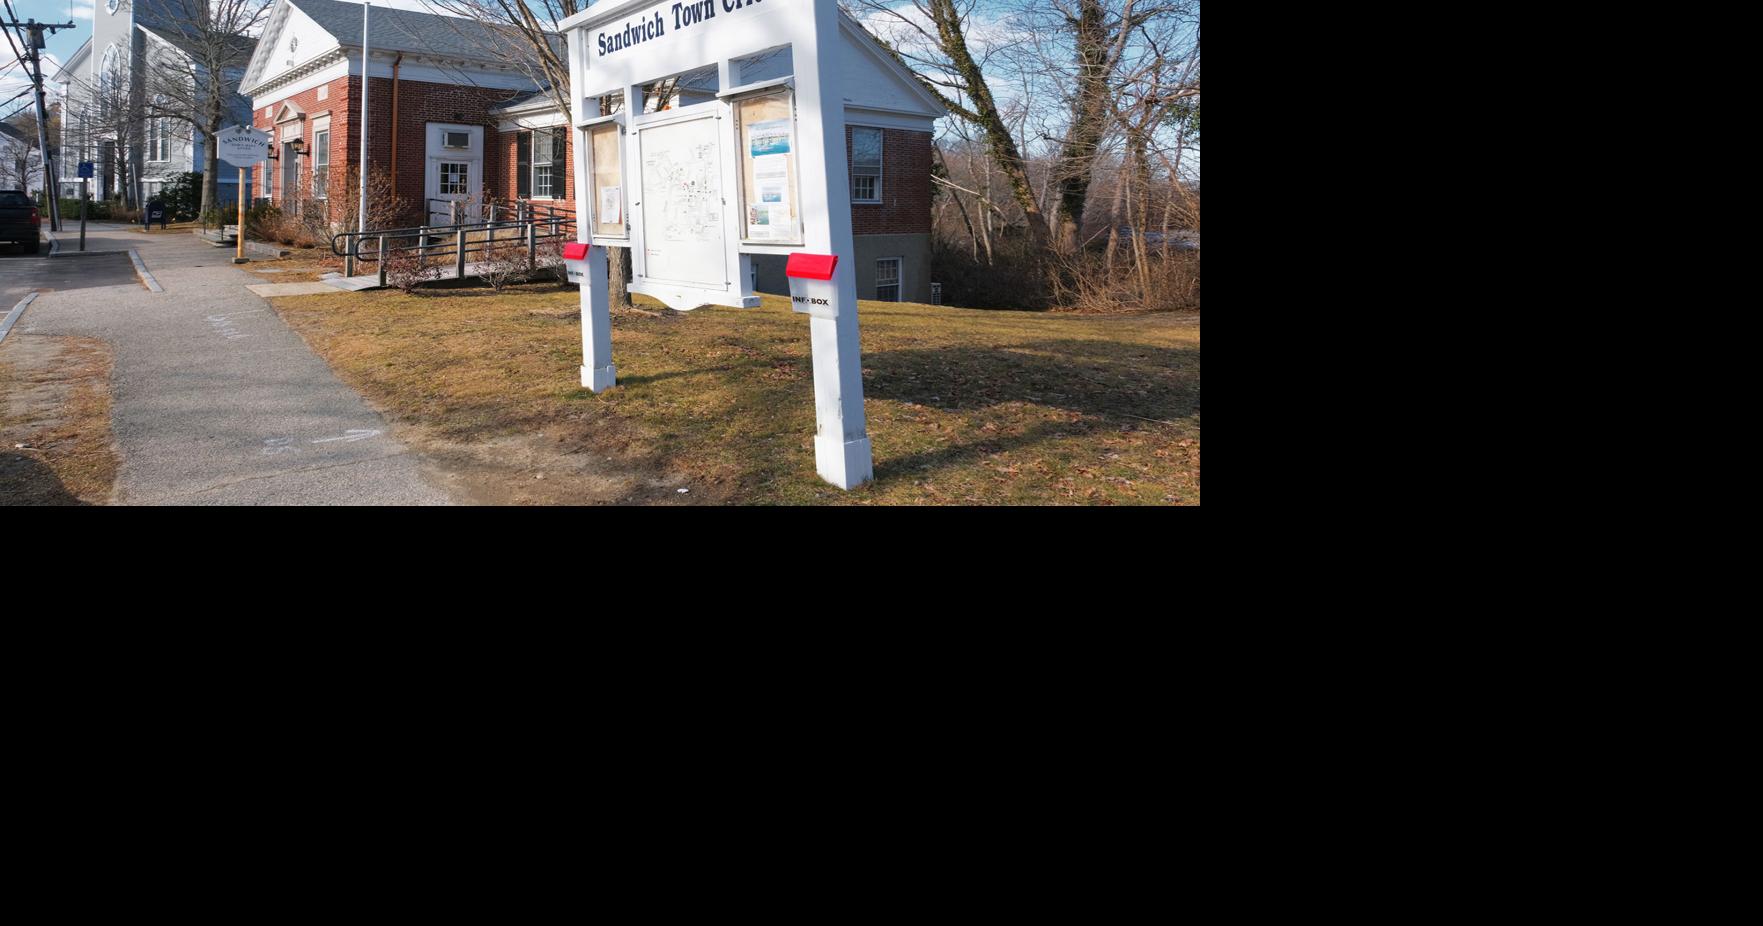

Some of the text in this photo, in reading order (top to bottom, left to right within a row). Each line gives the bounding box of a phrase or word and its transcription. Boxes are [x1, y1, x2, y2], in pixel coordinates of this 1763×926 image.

[598, 11, 665, 56] Sandwich
[671, 0, 716, 30] Town
[222, 136, 265, 147] SANDWICH
